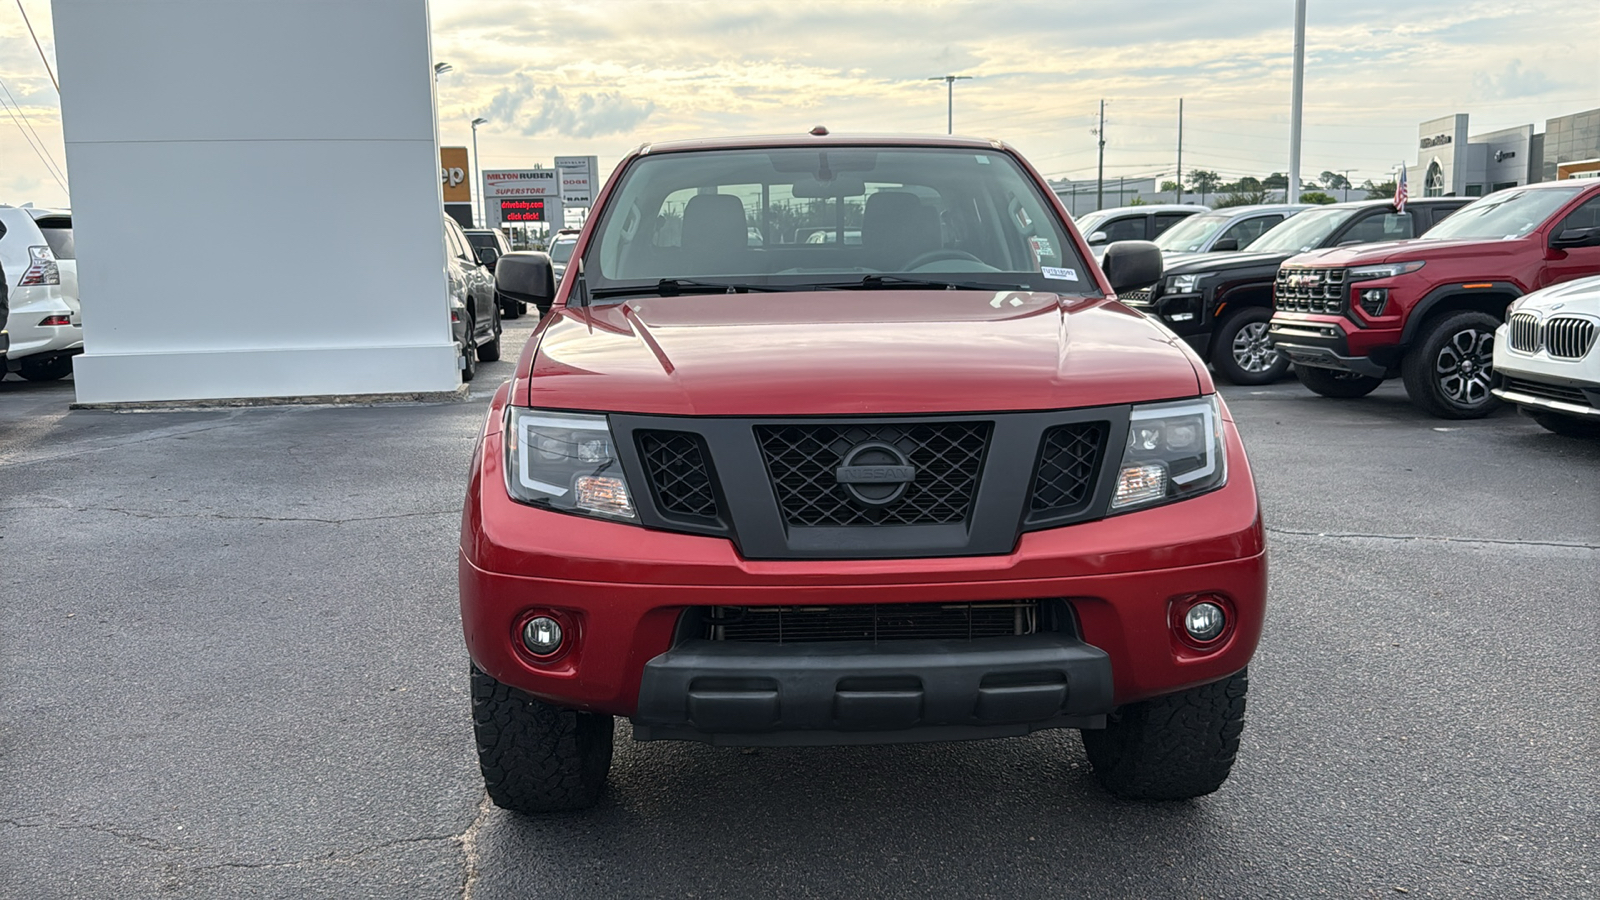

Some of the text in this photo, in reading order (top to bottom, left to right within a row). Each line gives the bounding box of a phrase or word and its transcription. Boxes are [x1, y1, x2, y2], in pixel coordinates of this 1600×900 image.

[495, 187, 546, 195] SUPERSTORE
[501, 201, 543, 210] drivebaby.com
[522, 212, 539, 220] click!
[845, 468, 907, 479] NISSAN
